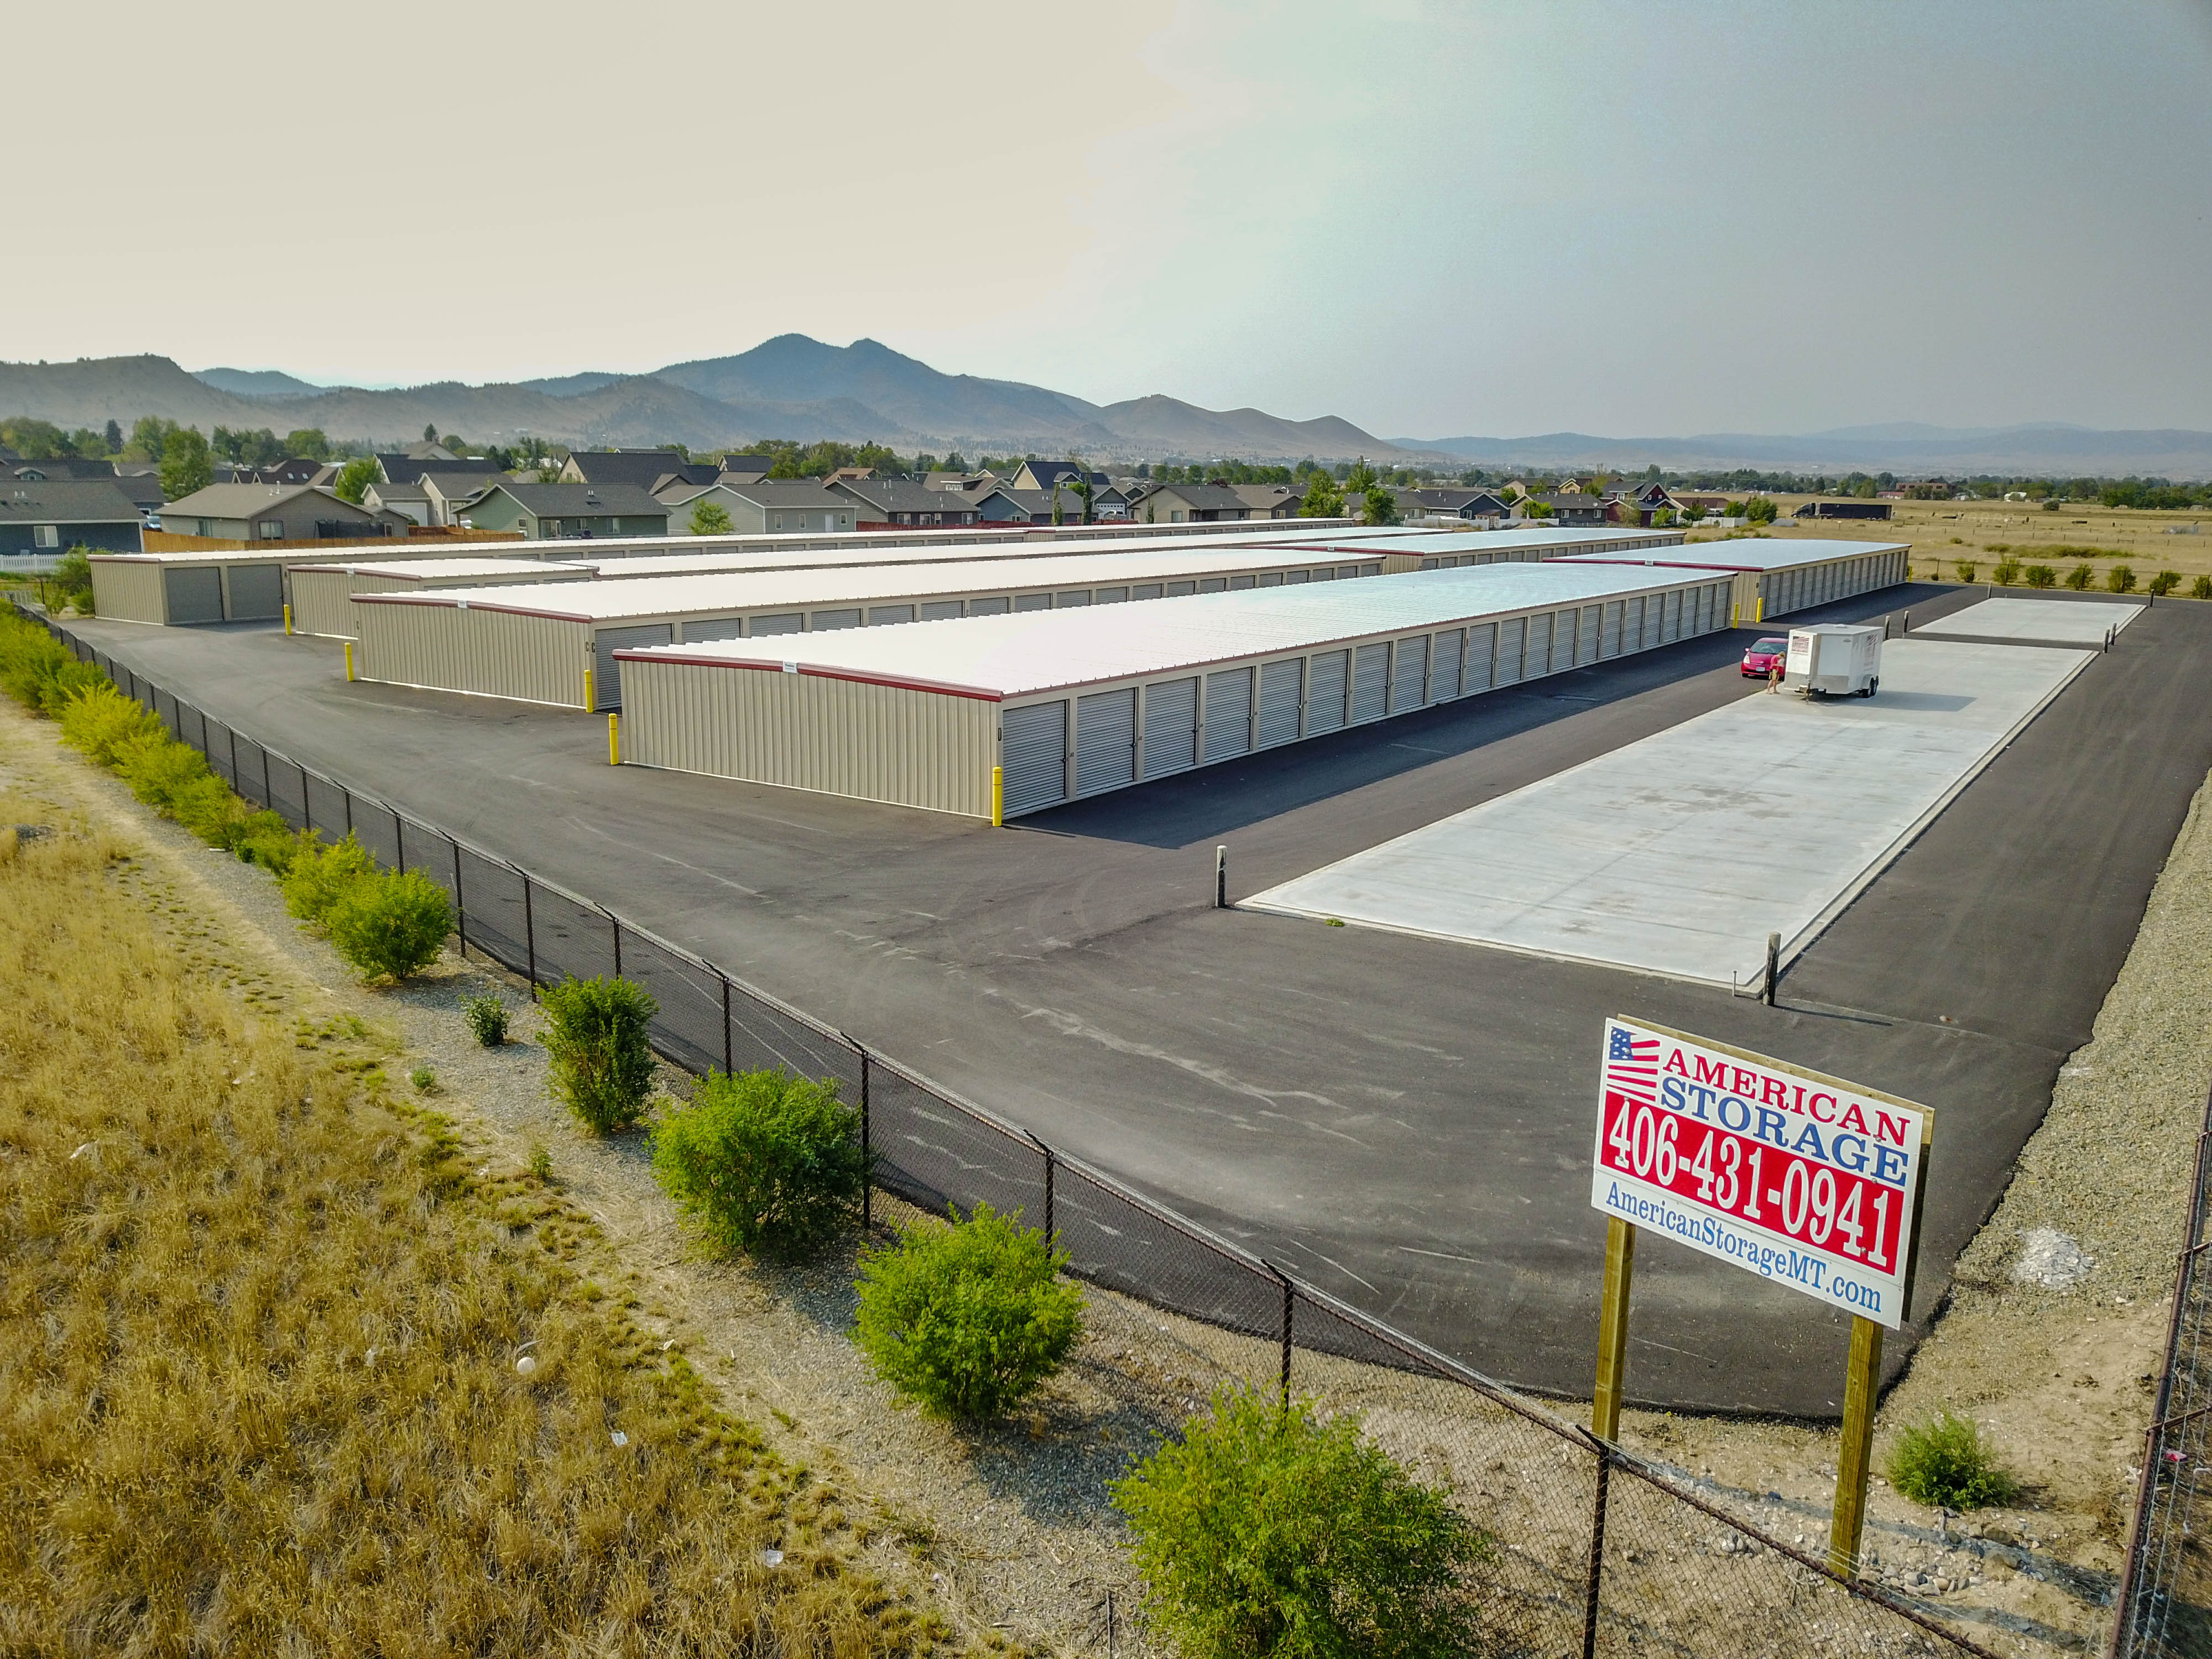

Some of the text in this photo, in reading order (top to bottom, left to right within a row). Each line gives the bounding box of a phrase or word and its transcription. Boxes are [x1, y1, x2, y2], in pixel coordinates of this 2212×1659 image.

[586, 641, 589, 652] C
[591, 642, 596, 653] C
[1661, 1076, 1908, 1187] STORAGE
[1662, 1048, 1910, 1147] AMERICAN
[1609, 1100, 1890, 1267] 406-431-0941
[1606, 1181, 1881, 1313] AmericanStorageMT.com
